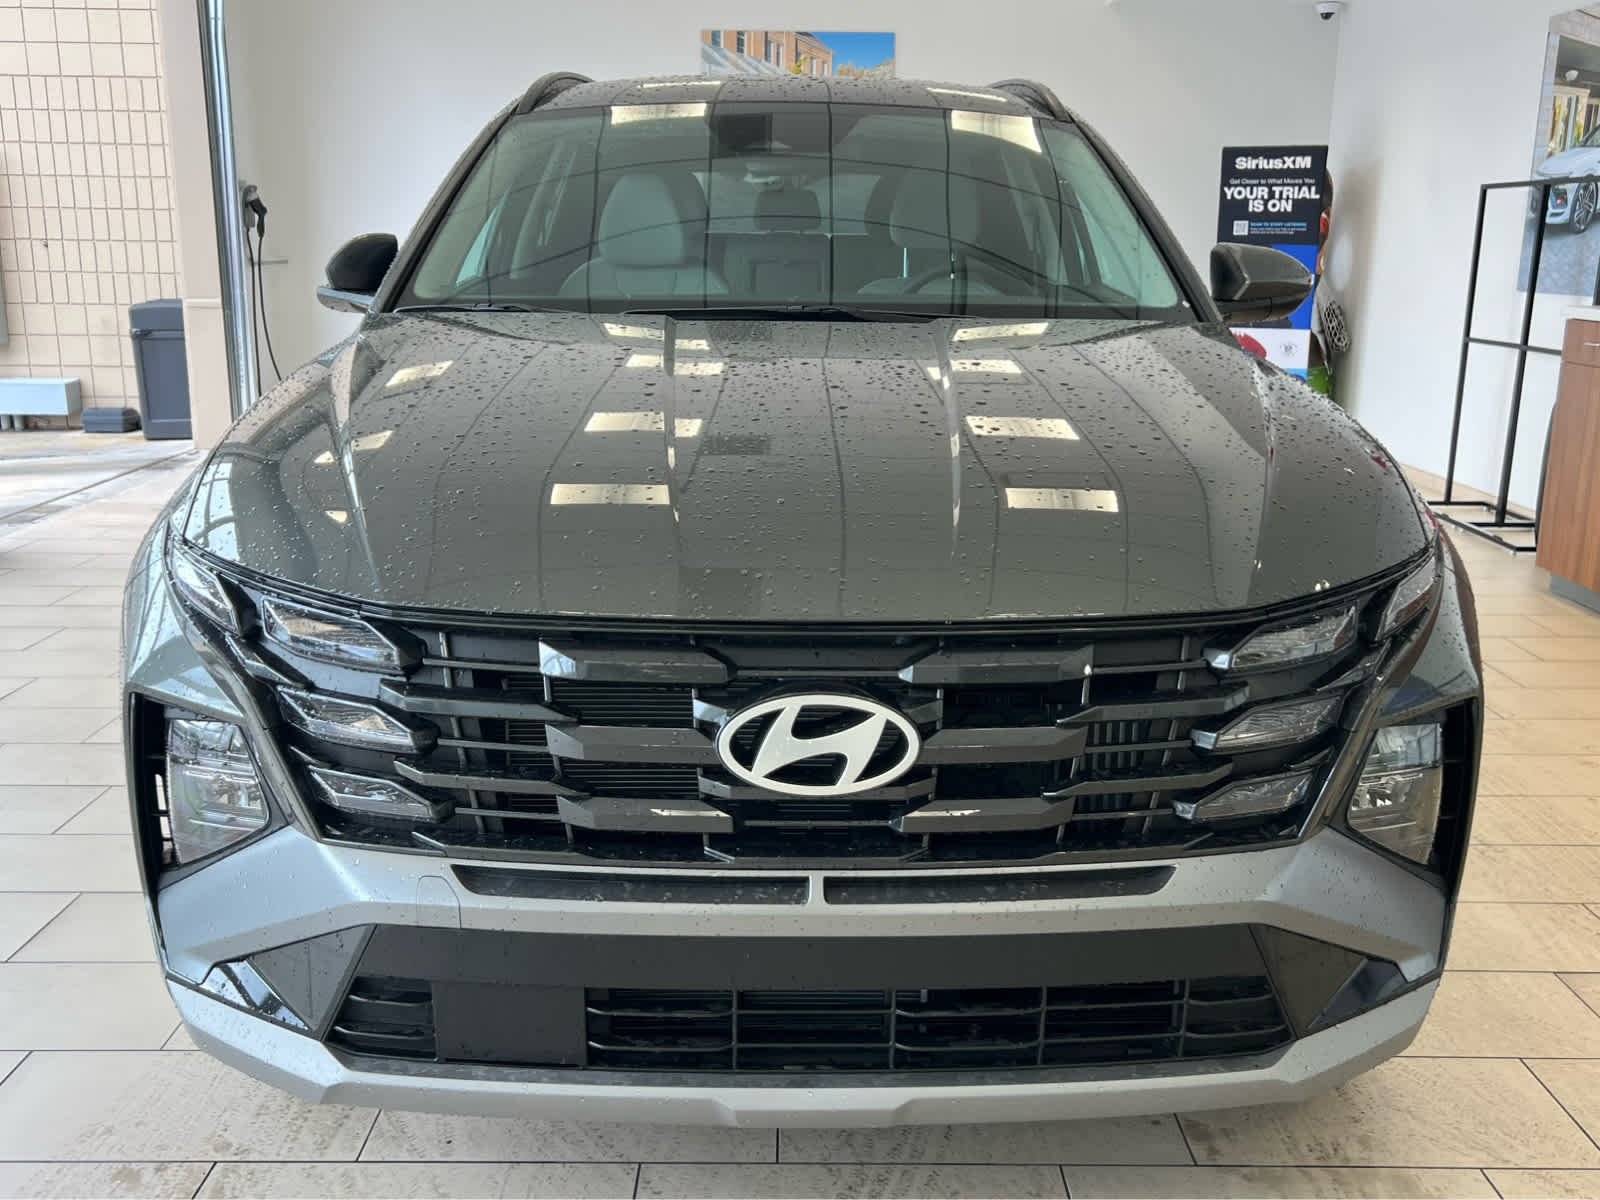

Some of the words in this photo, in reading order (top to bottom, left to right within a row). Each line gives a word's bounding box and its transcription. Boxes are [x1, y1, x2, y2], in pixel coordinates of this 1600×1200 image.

[1234, 156, 1312, 170] SiriusXM
[1224, 186, 1269, 200] YOUR
[1272, 186, 1320, 200] TRIAL
[1248, 200, 1264, 212] IS
[1267, 200, 1293, 213] ON
